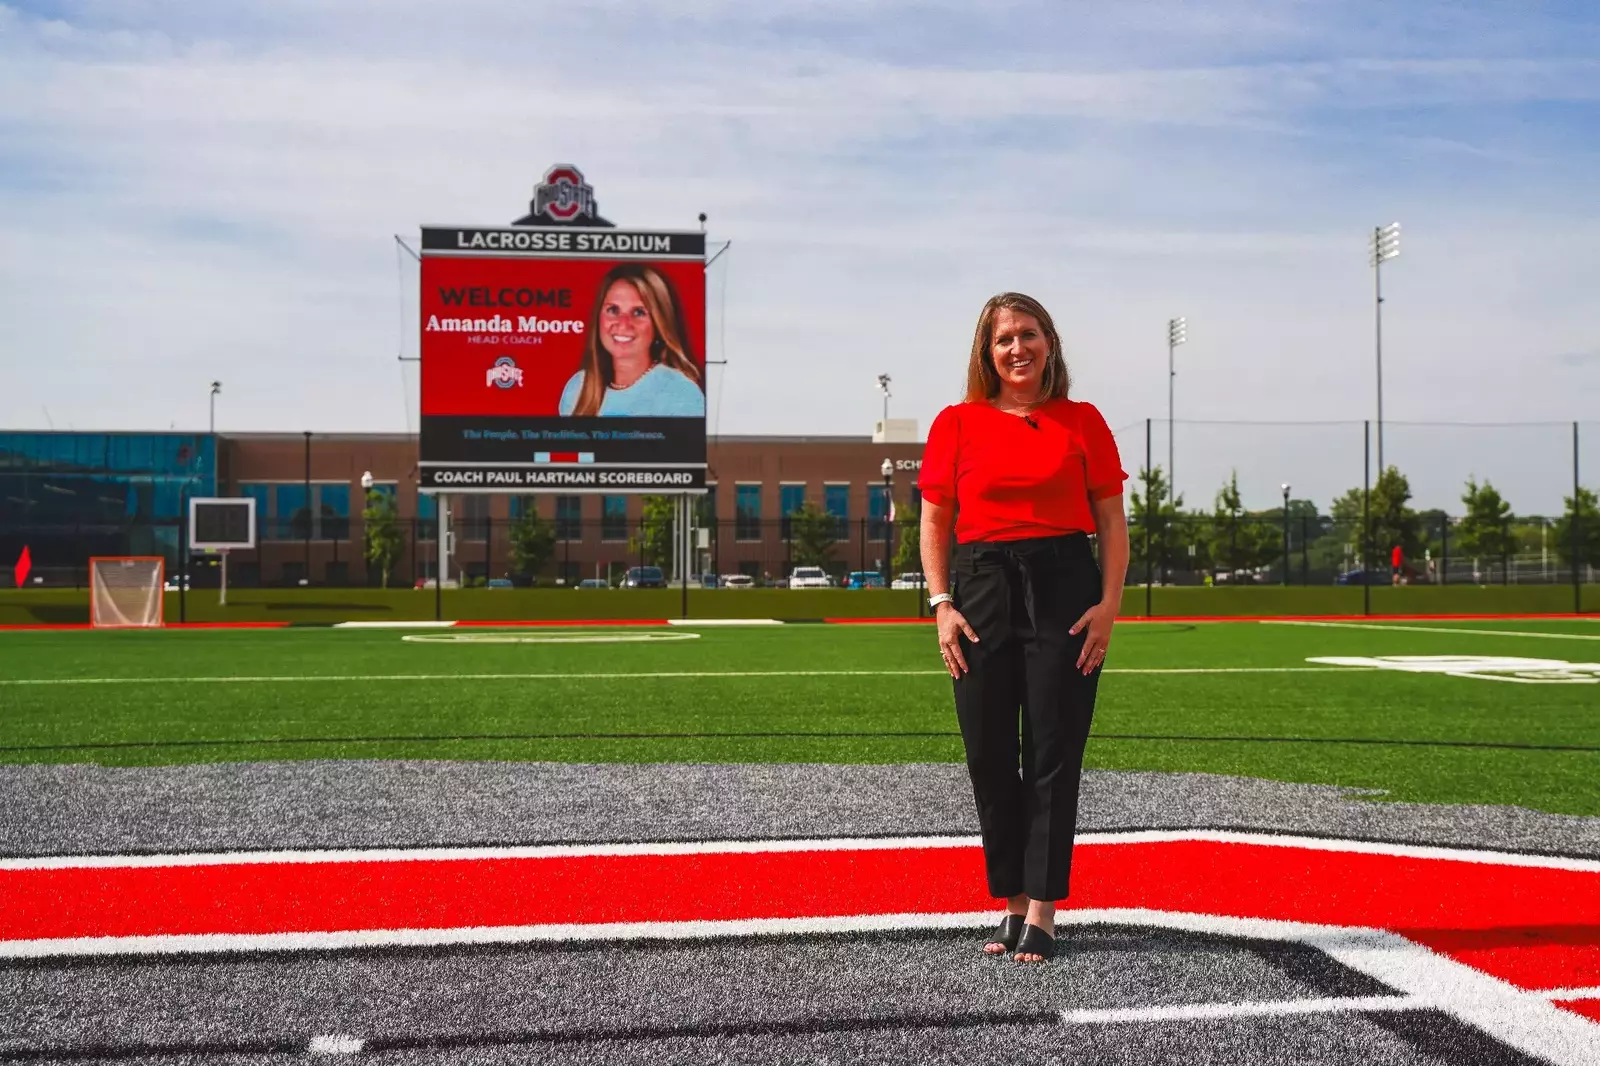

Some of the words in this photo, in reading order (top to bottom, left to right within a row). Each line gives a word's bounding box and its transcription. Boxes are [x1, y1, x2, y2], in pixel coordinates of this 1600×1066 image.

[457, 231, 571, 250] LACROSSE
[576, 233, 671, 252] STADIUM
[438, 286, 572, 308] WELCOME
[425, 314, 513, 332] Amanda
[517, 315, 585, 334] Moore
[467, 335, 499, 345] HEAD
[502, 335, 542, 346] COACH
[433, 471, 483, 483] COACH
[486, 471, 523, 483] PAUL
[526, 471, 596, 484] HARTMAN
[598, 472, 693, 484] SCOREBOARD
